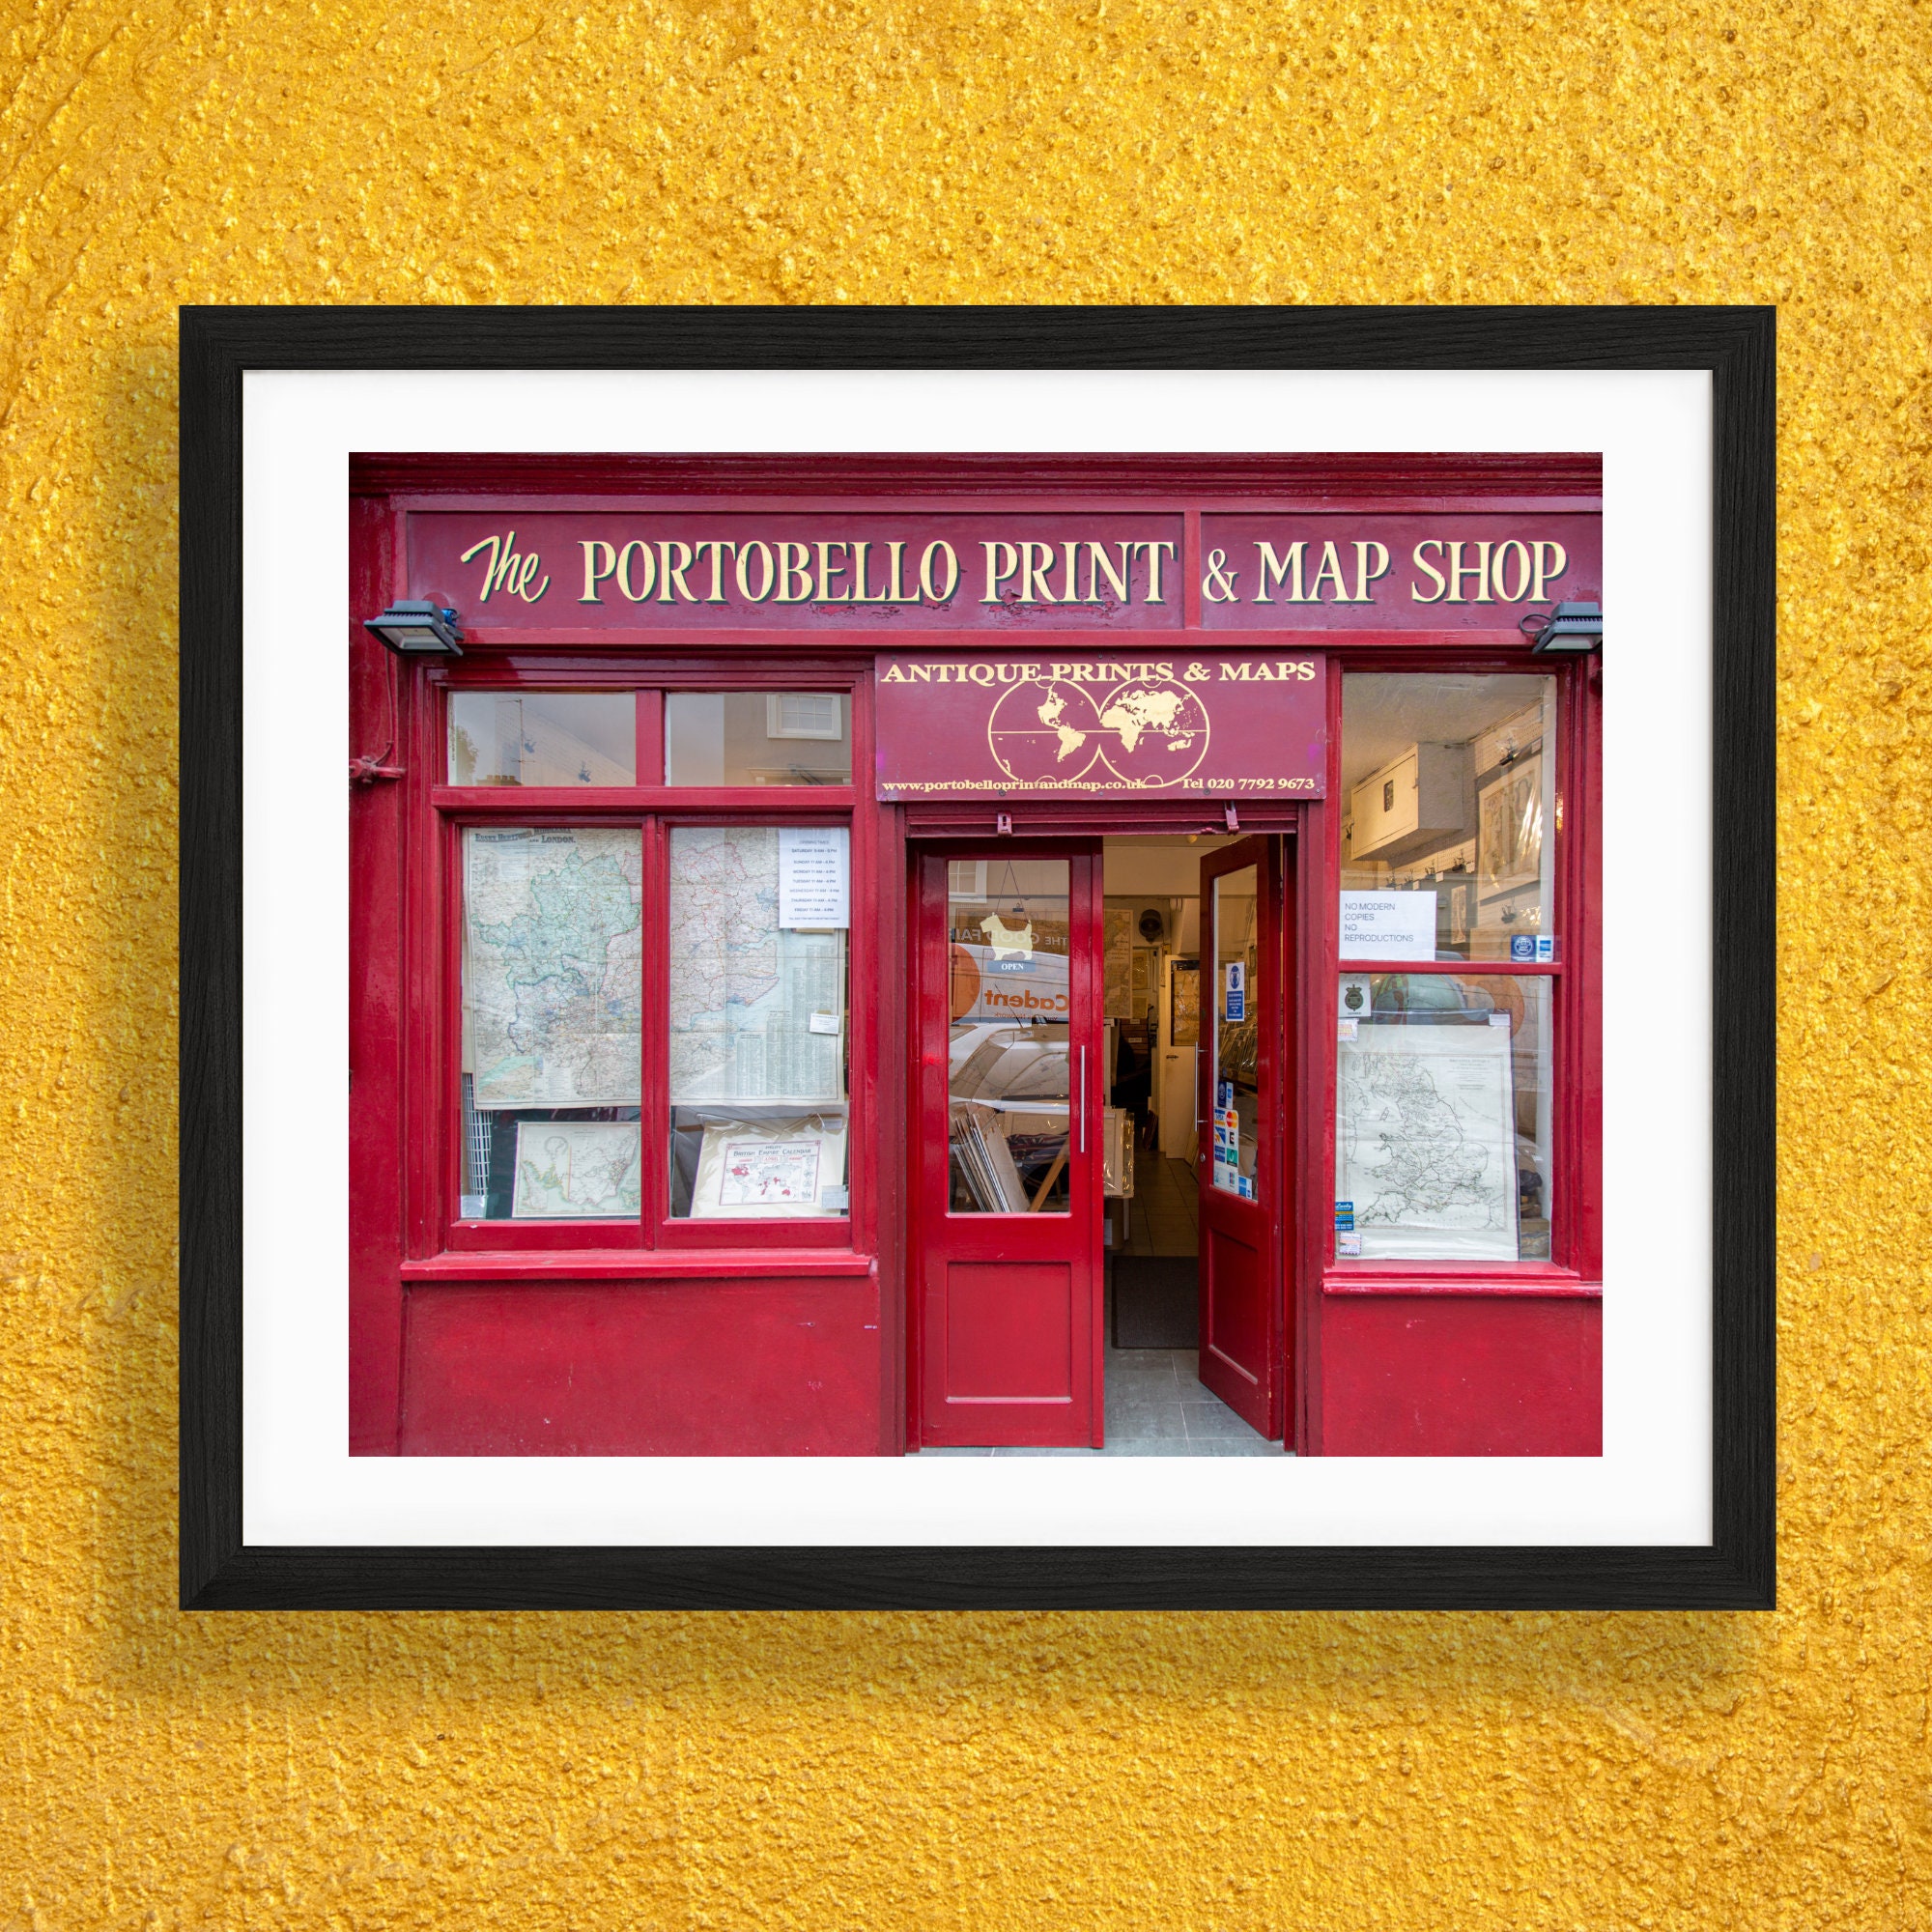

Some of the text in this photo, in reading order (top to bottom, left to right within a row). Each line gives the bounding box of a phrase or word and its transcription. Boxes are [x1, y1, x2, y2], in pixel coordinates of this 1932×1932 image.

[460, 530, 1569, 605] The PORTOBELLO PRINT & MAP SHOP
[880, 661, 1316, 687] ANTIQUE PRINTS & MAPS
[1181, 777, 1316, 790] Tel 020 7792 9673
[1345, 902, 1396, 911] NO MODERN
[1345, 913, 1375, 922] COPIES
[1344, 933, 1414, 942] REPRODUCTIONS
